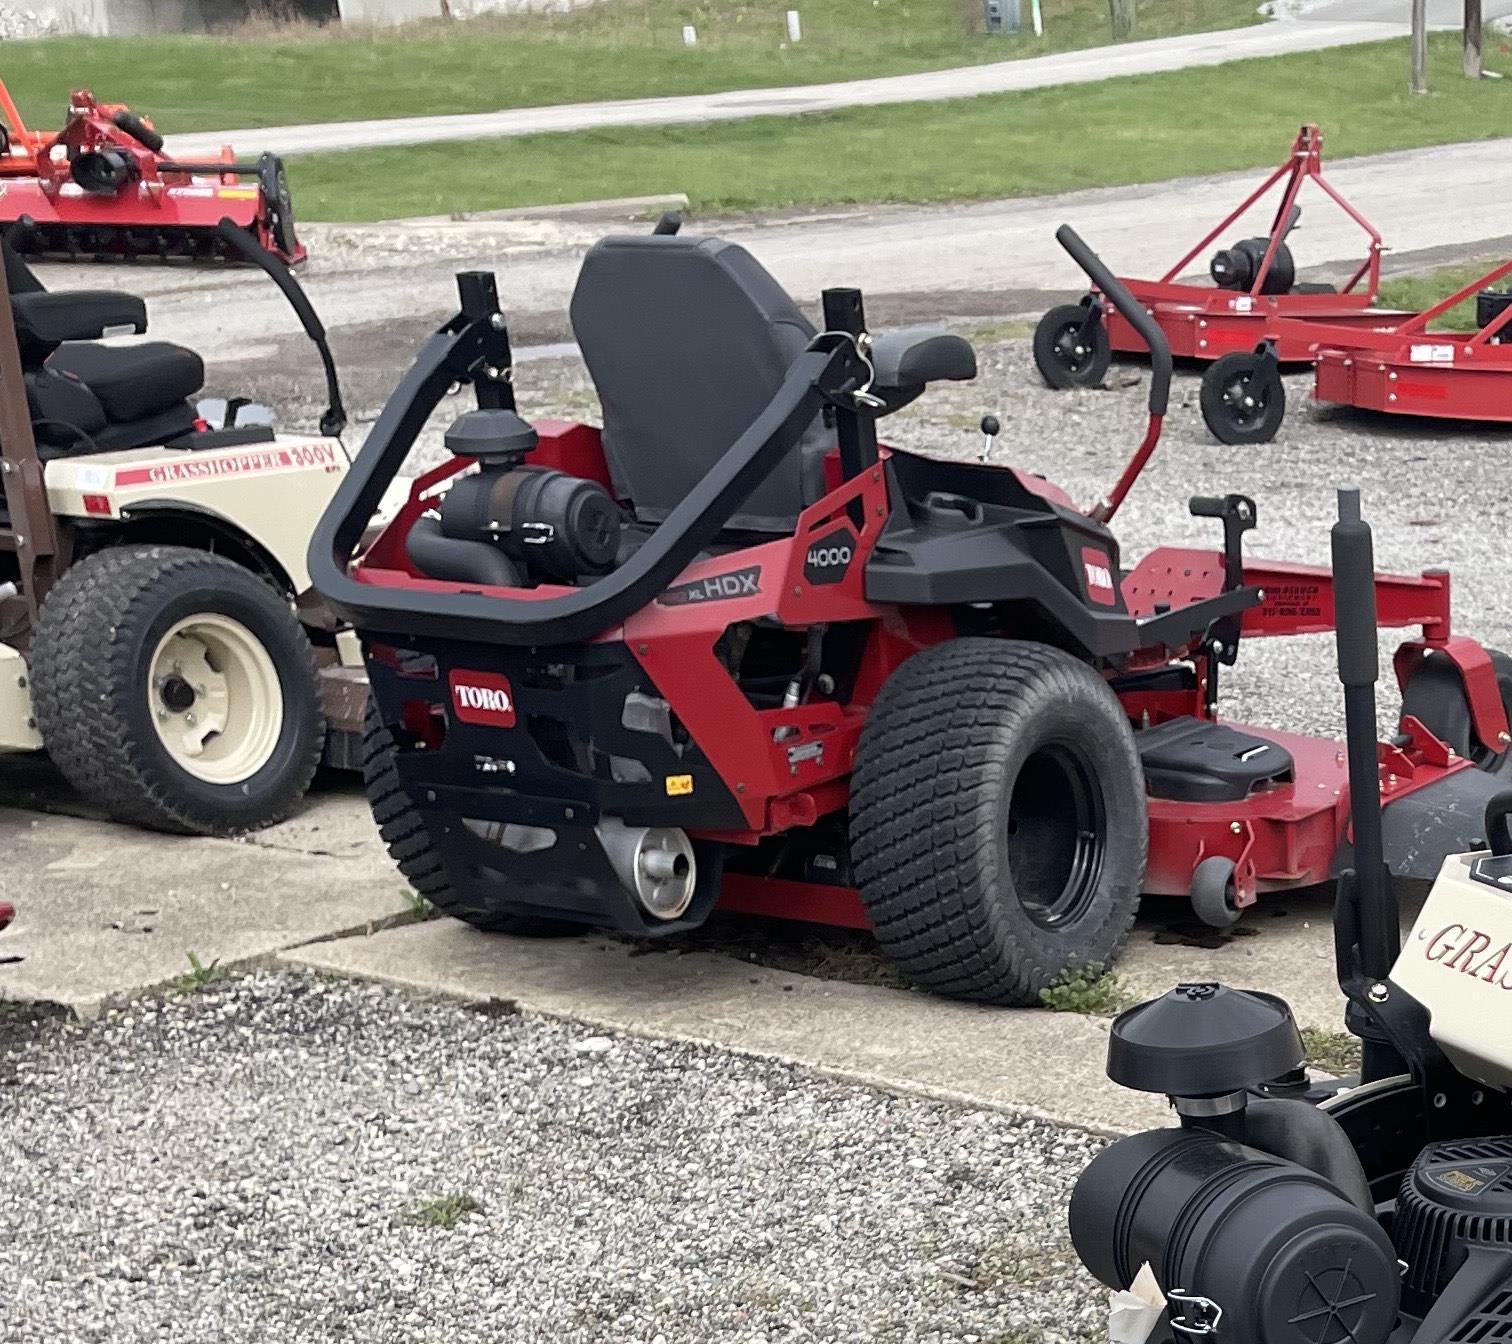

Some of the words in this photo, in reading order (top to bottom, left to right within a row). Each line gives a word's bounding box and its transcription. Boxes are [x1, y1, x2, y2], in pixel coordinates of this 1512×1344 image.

[150, 451, 282, 481] GRASSHOPPER
[807, 546, 850, 567] 4000
[688, 588, 704, 600] XL
[704, 573, 756, 598] HDX
[455, 684, 511, 712] TORO
